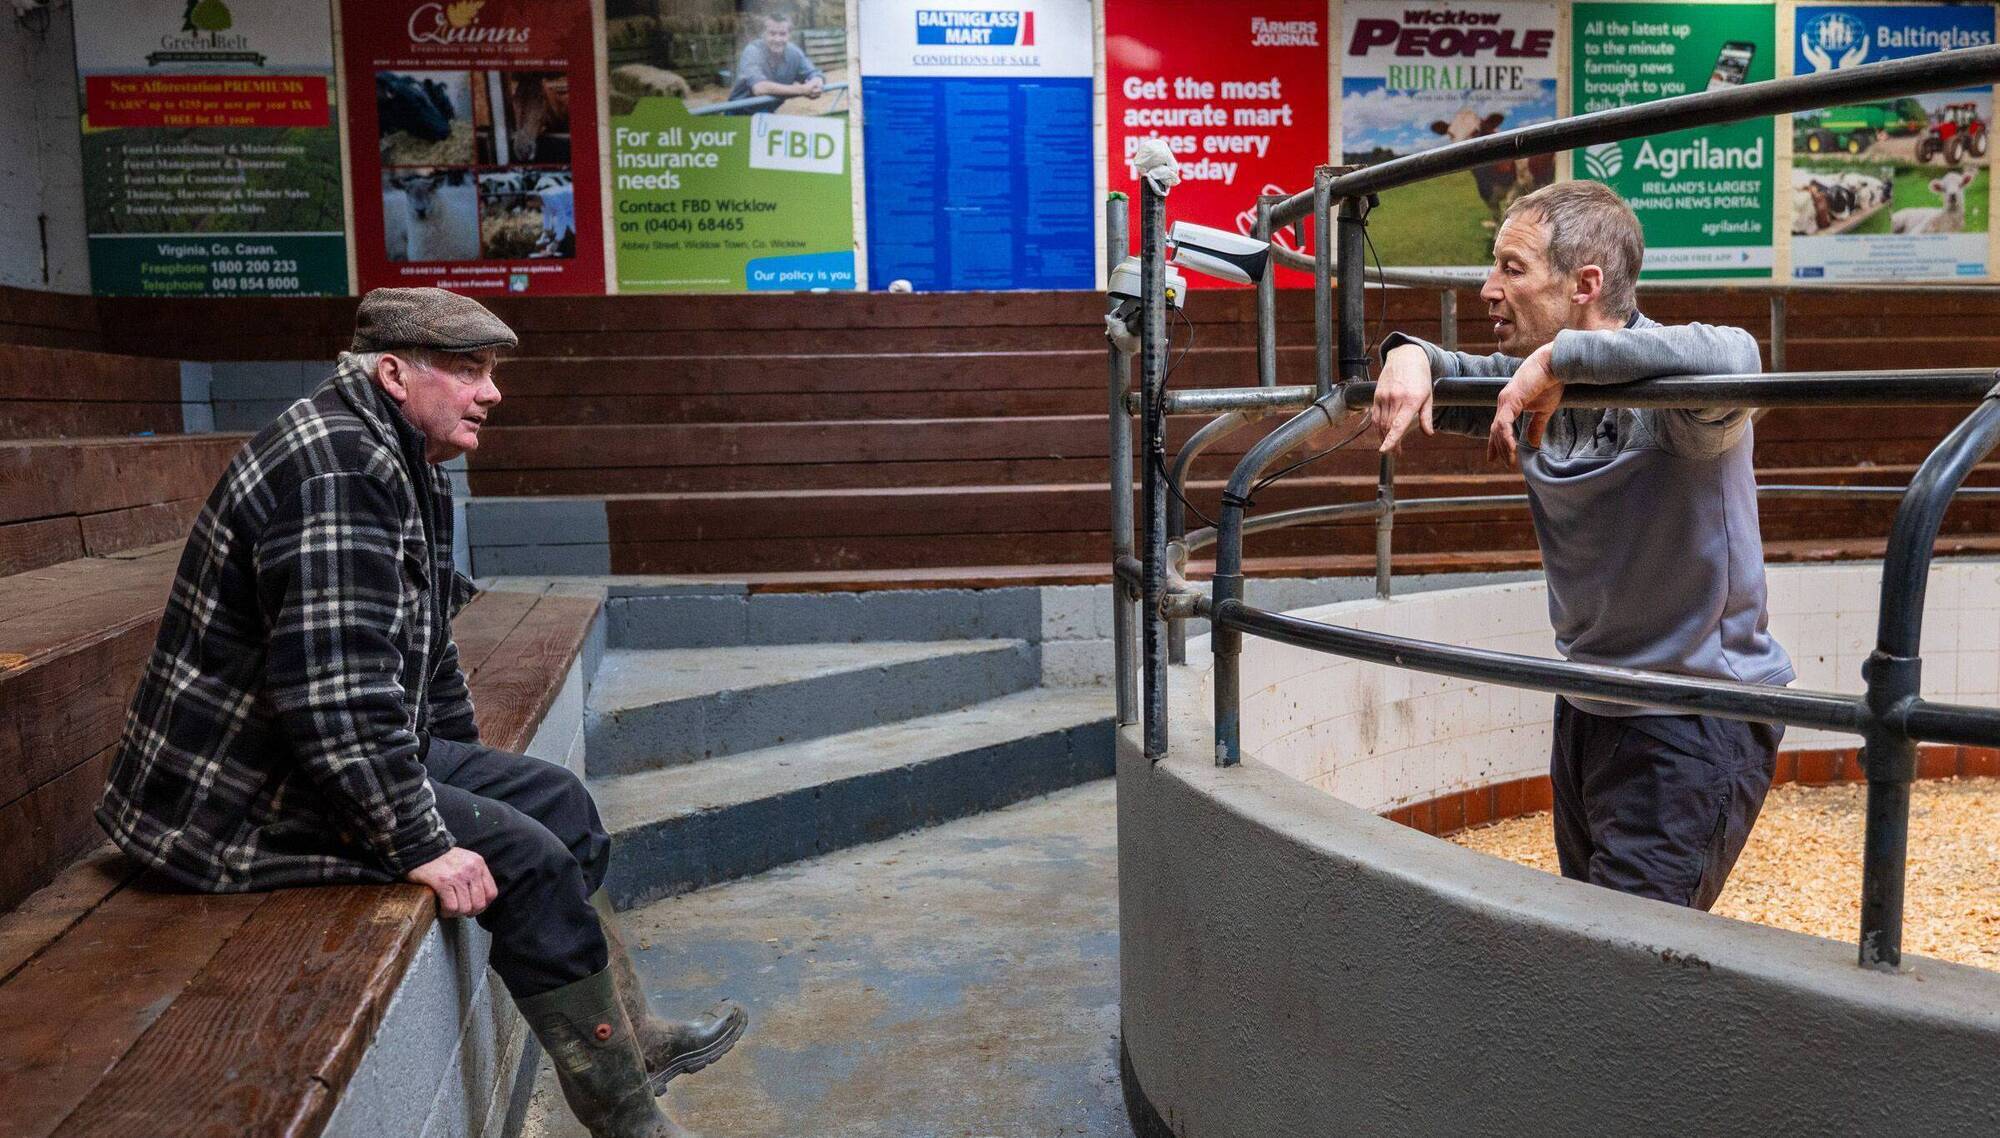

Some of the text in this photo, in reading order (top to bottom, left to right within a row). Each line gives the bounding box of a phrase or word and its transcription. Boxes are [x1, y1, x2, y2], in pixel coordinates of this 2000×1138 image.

[408, 2, 531, 44] Quinns
[918, 11, 1018, 27] BALTINGLASS
[1251, 20, 1317, 34] FARMERS
[945, 28, 992, 44] MART
[1348, 19, 1554, 57] PEOPLE
[1585, 21, 1690, 39] All the latest up
[1877, 25, 1990, 50] Baltinglass
[1251, 34, 1320, 46] JOURNAL
[1585, 42, 1675, 55] to the minute
[912, 54, 1041, 65] CONDITIONS OF SALE
[1585, 60, 1674, 77] farming news
[111, 81, 137, 92] New
[224, 80, 303, 92] PREMIUMS
[1123, 77, 1280, 99] Get the most
[1584, 79, 1686, 97] brought to you
[1124, 104, 1292, 127] accurate mart
[616, 128, 736, 149] For all your
[1124, 130, 1270, 158] pes every
[617, 150, 718, 168] insurance
[1633, 137, 1764, 178] Agriland
[1124, 157, 1238, 185] Tsday
[158, 175, 183, 184] Road
[618, 172, 680, 190] needs
[1643, 180, 1761, 193] IRELAND'S LARGEST
[285, 190, 310, 199] Sales
[239, 204, 265, 213] Sales
[620, 200, 777, 214] Contact FBD Wicklow
[1624, 197, 1760, 209] ARMING NEWS PORTAL
[621, 218, 744, 233] on (0404) 68465
[1702, 220, 1762, 236] agriland.ie
[158, 243, 277, 258] Virginia, Co. Cavan.
[622, 242, 648, 250] Abbey
[684, 240, 722, 249] Wicklow
[771, 239, 806, 248] Wicklow
[1669, 254, 1688, 262] OUR
[1690, 253, 1712, 261] FREE
[1714, 253, 1731, 261] APP
[141, 260, 297, 276] Freephone 1800 200 233
[754, 269, 851, 282] Our policy is you
[142, 277, 299, 291] Telephone 049 854 8000
